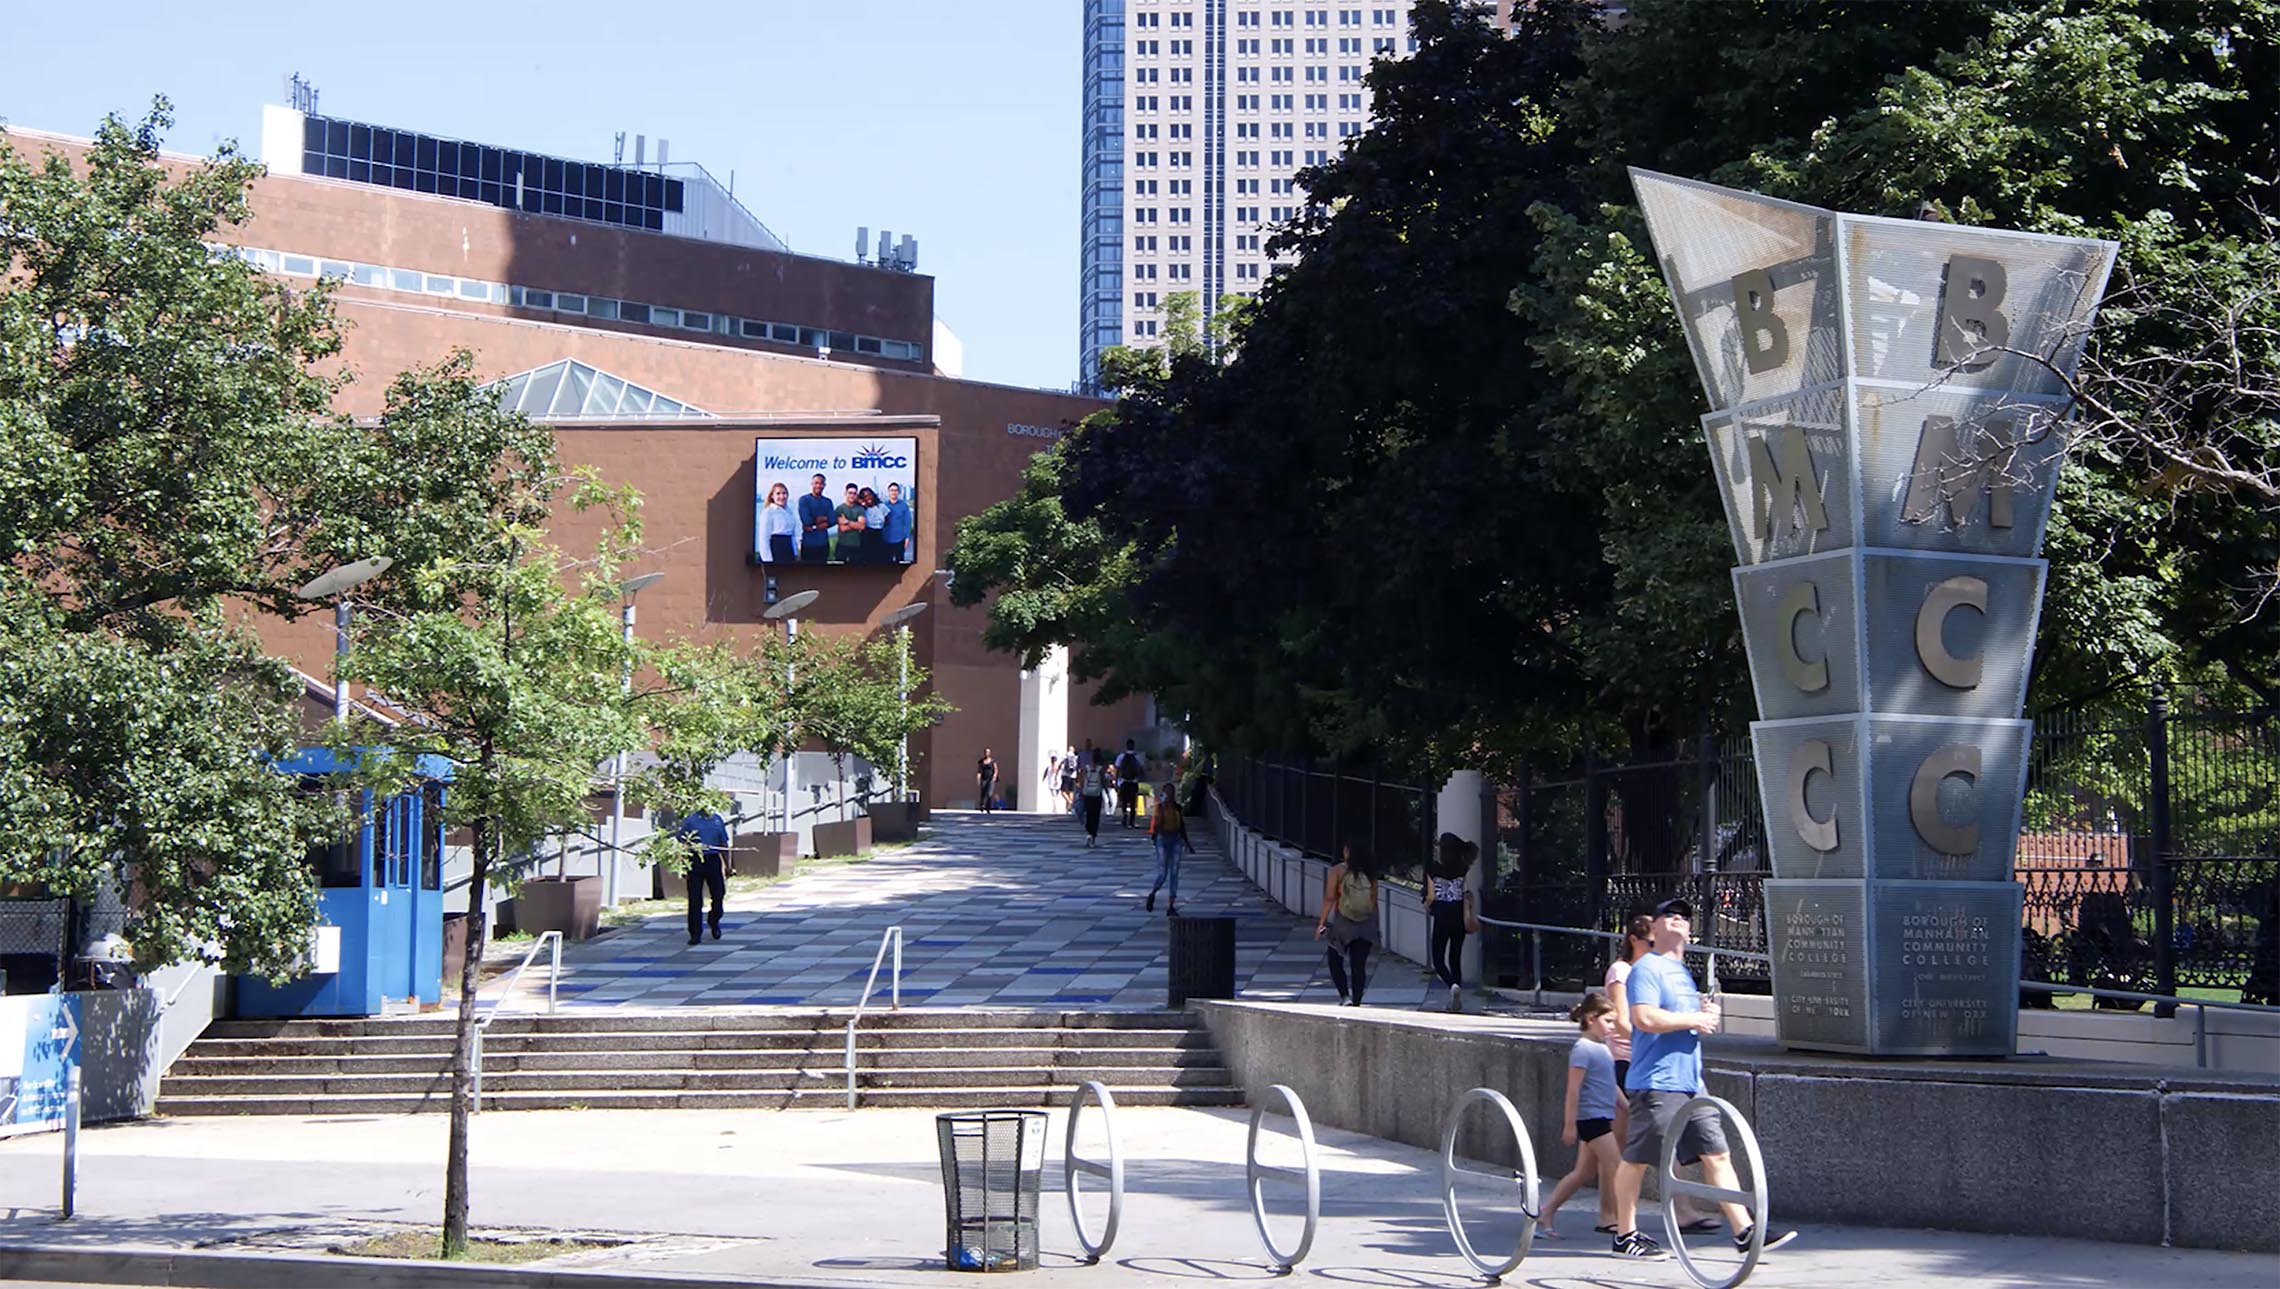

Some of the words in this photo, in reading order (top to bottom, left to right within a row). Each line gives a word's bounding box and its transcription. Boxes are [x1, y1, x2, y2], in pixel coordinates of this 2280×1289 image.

[1007, 423, 1057, 438] BOROUGH
[764, 456, 828, 469] Welcome
[833, 456, 847, 469] to
[1786, 914, 1830, 925] BOROUGH
[1833, 914, 1844, 925] OF
[1903, 915, 1968, 927] BOROUGH
[1972, 916, 1988, 927] OF
[1788, 926, 1845, 937] MANHTTAN
[1903, 928, 1990, 939] MANHATTAN
[1788, 939, 1845, 950] COMMUNITY
[1903, 941, 1987, 952] COMMUNITY
[1788, 951, 1847, 963] COLLEGE
[1902, 955, 1990, 966] COLLEGE
